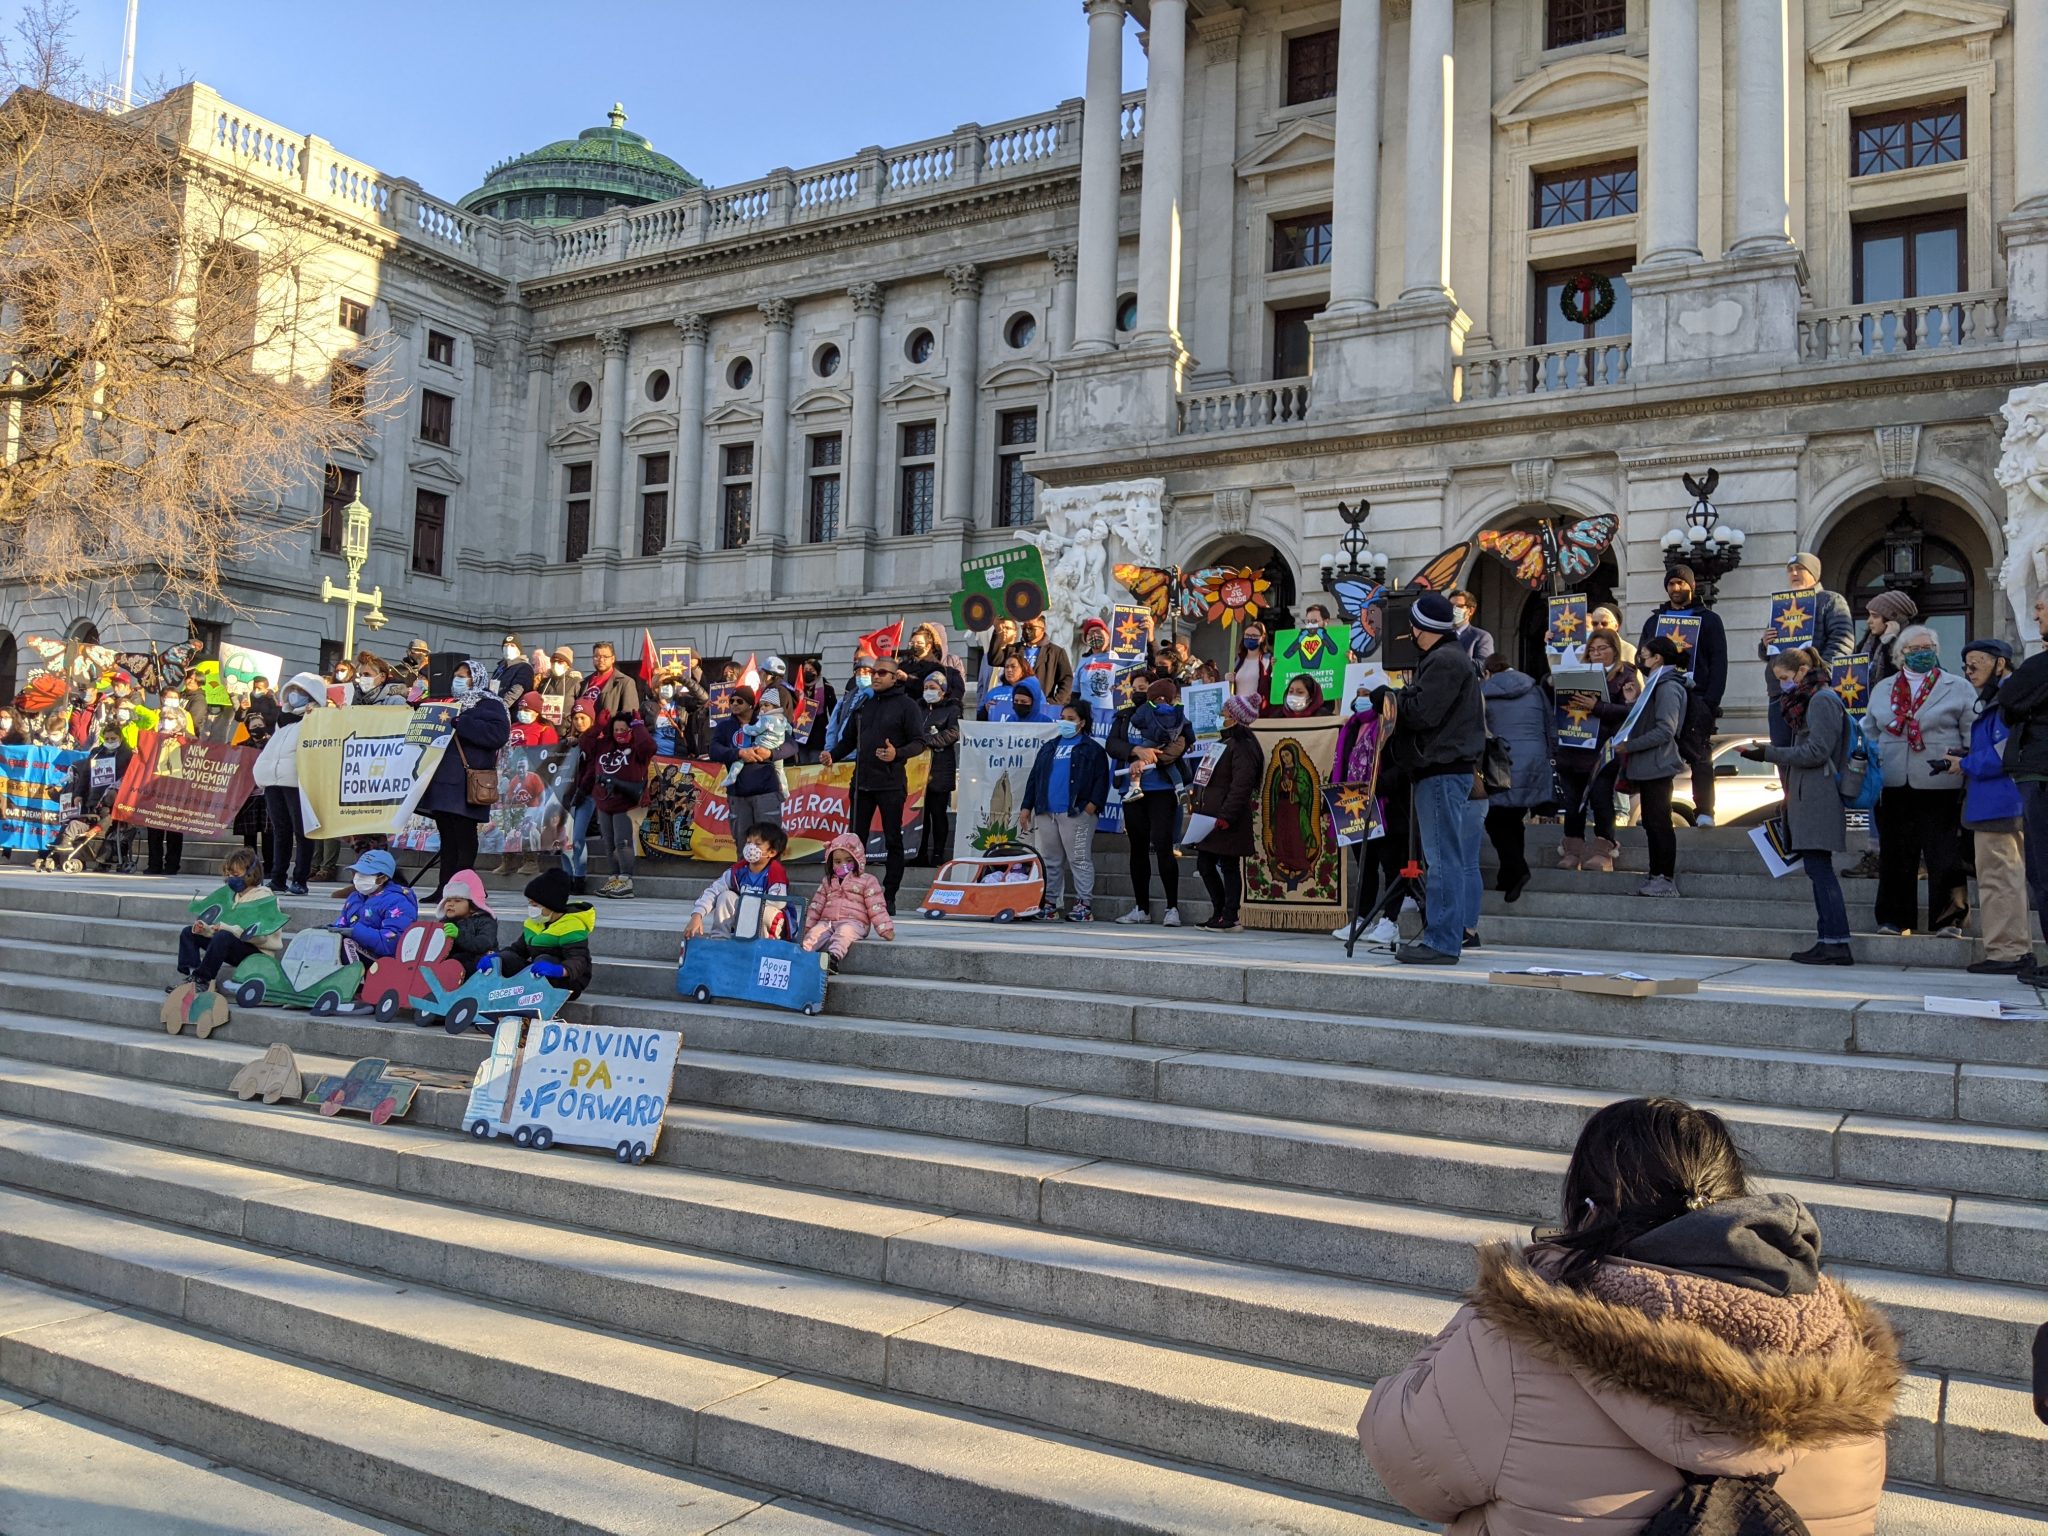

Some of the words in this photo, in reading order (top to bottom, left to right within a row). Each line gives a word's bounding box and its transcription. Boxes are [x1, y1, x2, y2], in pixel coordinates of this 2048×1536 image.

[302, 738, 341, 748] SUPPORT!
[345, 742, 405, 757] DRIVING
[1007, 735, 1046, 749] Licens
[188, 745, 208, 757] NEW
[184, 757, 240, 775] SANCTUARY
[344, 761, 361, 776] PA
[989, 754, 1006, 768] for
[1008, 754, 1023, 768] All
[182, 768, 232, 786] MOVEMENT
[343, 777, 411, 794] FORWARD
[5, 808, 20, 817] OUR
[117, 803, 136, 813] Grupo
[704, 800, 731, 821] MA
[781, 794, 803, 816] HE
[781, 816, 850, 834] NSYLVANI
[1340, 820, 1378, 835] PENNSYLVNIA
[1350, 817, 1365, 827] PARA
[762, 958, 788, 972] Apoya
[759, 972, 789, 988] HB-279
[489, 988, 512, 1000] places
[513, 986, 524, 995] we
[538, 1023, 661, 1063] DRIVING
[568, 1057, 612, 1091] PA
[530, 1080, 666, 1127] FORWARD
